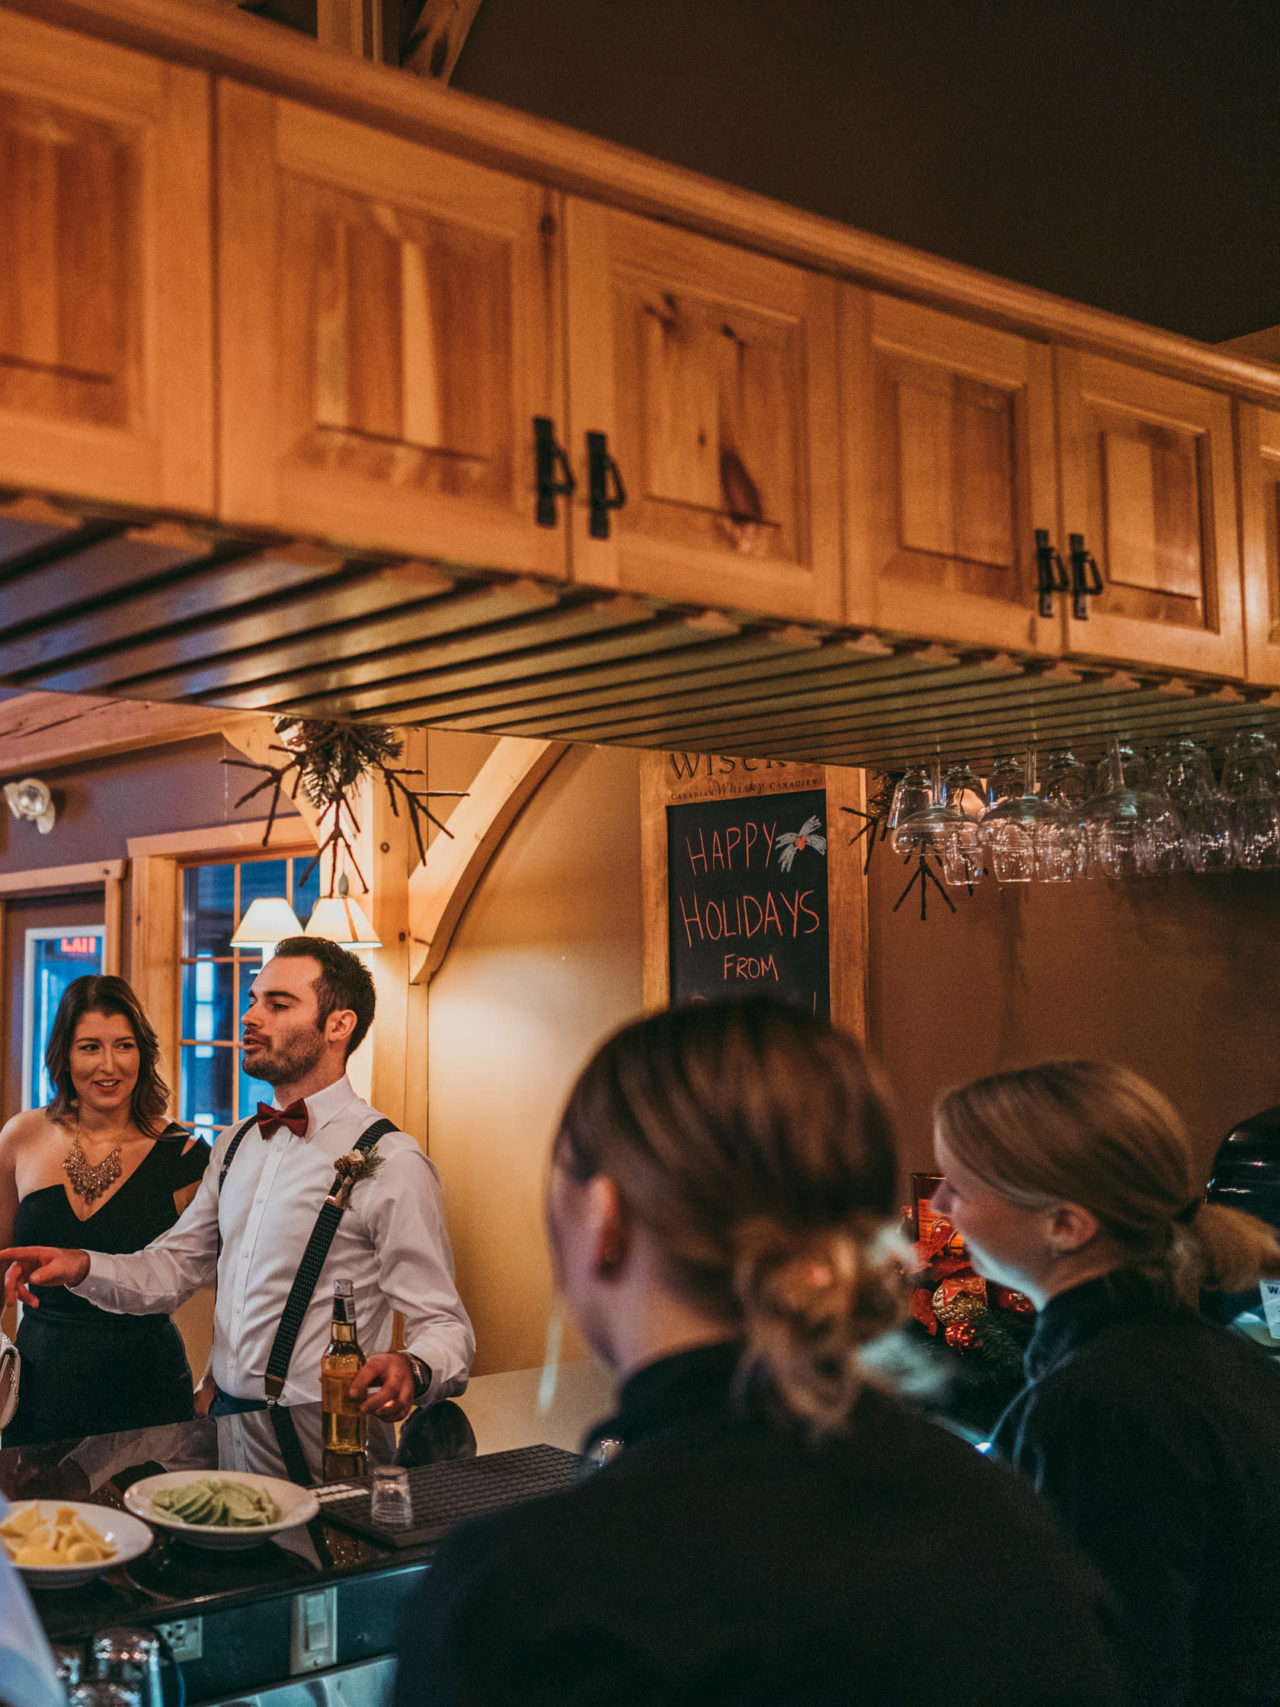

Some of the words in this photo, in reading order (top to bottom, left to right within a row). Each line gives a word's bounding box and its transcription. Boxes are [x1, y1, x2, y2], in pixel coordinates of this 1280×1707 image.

[714, 780, 765, 796] Whisky
[686, 822, 777, 876] HAPPY
[679, 890, 820, 948] HOLIDAYS
[723, 953, 779, 982] FROM
